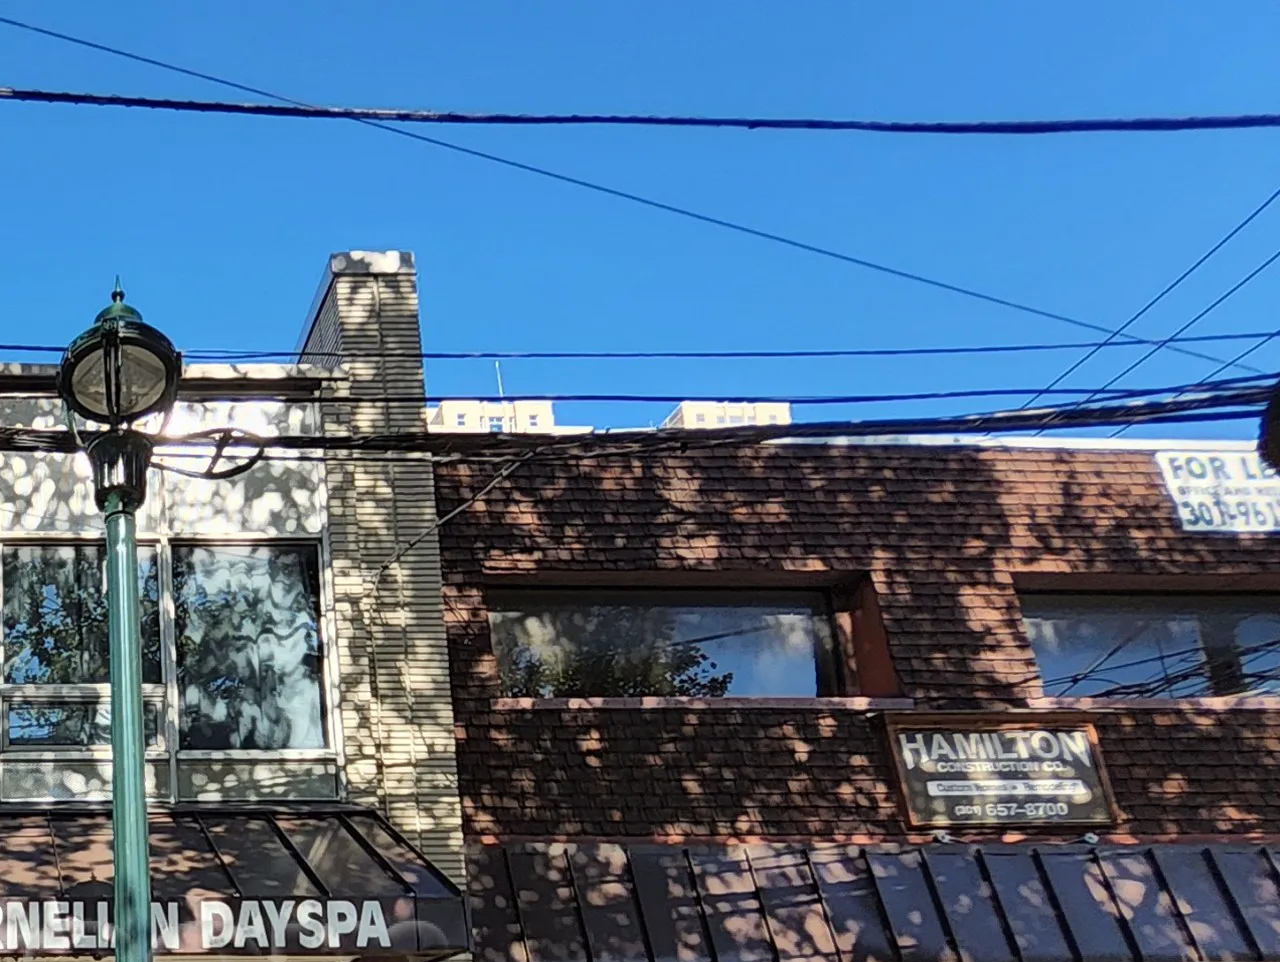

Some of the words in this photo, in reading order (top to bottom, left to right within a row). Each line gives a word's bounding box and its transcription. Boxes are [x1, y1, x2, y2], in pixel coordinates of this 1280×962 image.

[1168, 456, 1232, 480] FOR
[898, 730, 1092, 770] HAMILTON
[936, 761, 1040, 773] CONSTRUCTION
[985, 802, 1069, 817] 657-8700
